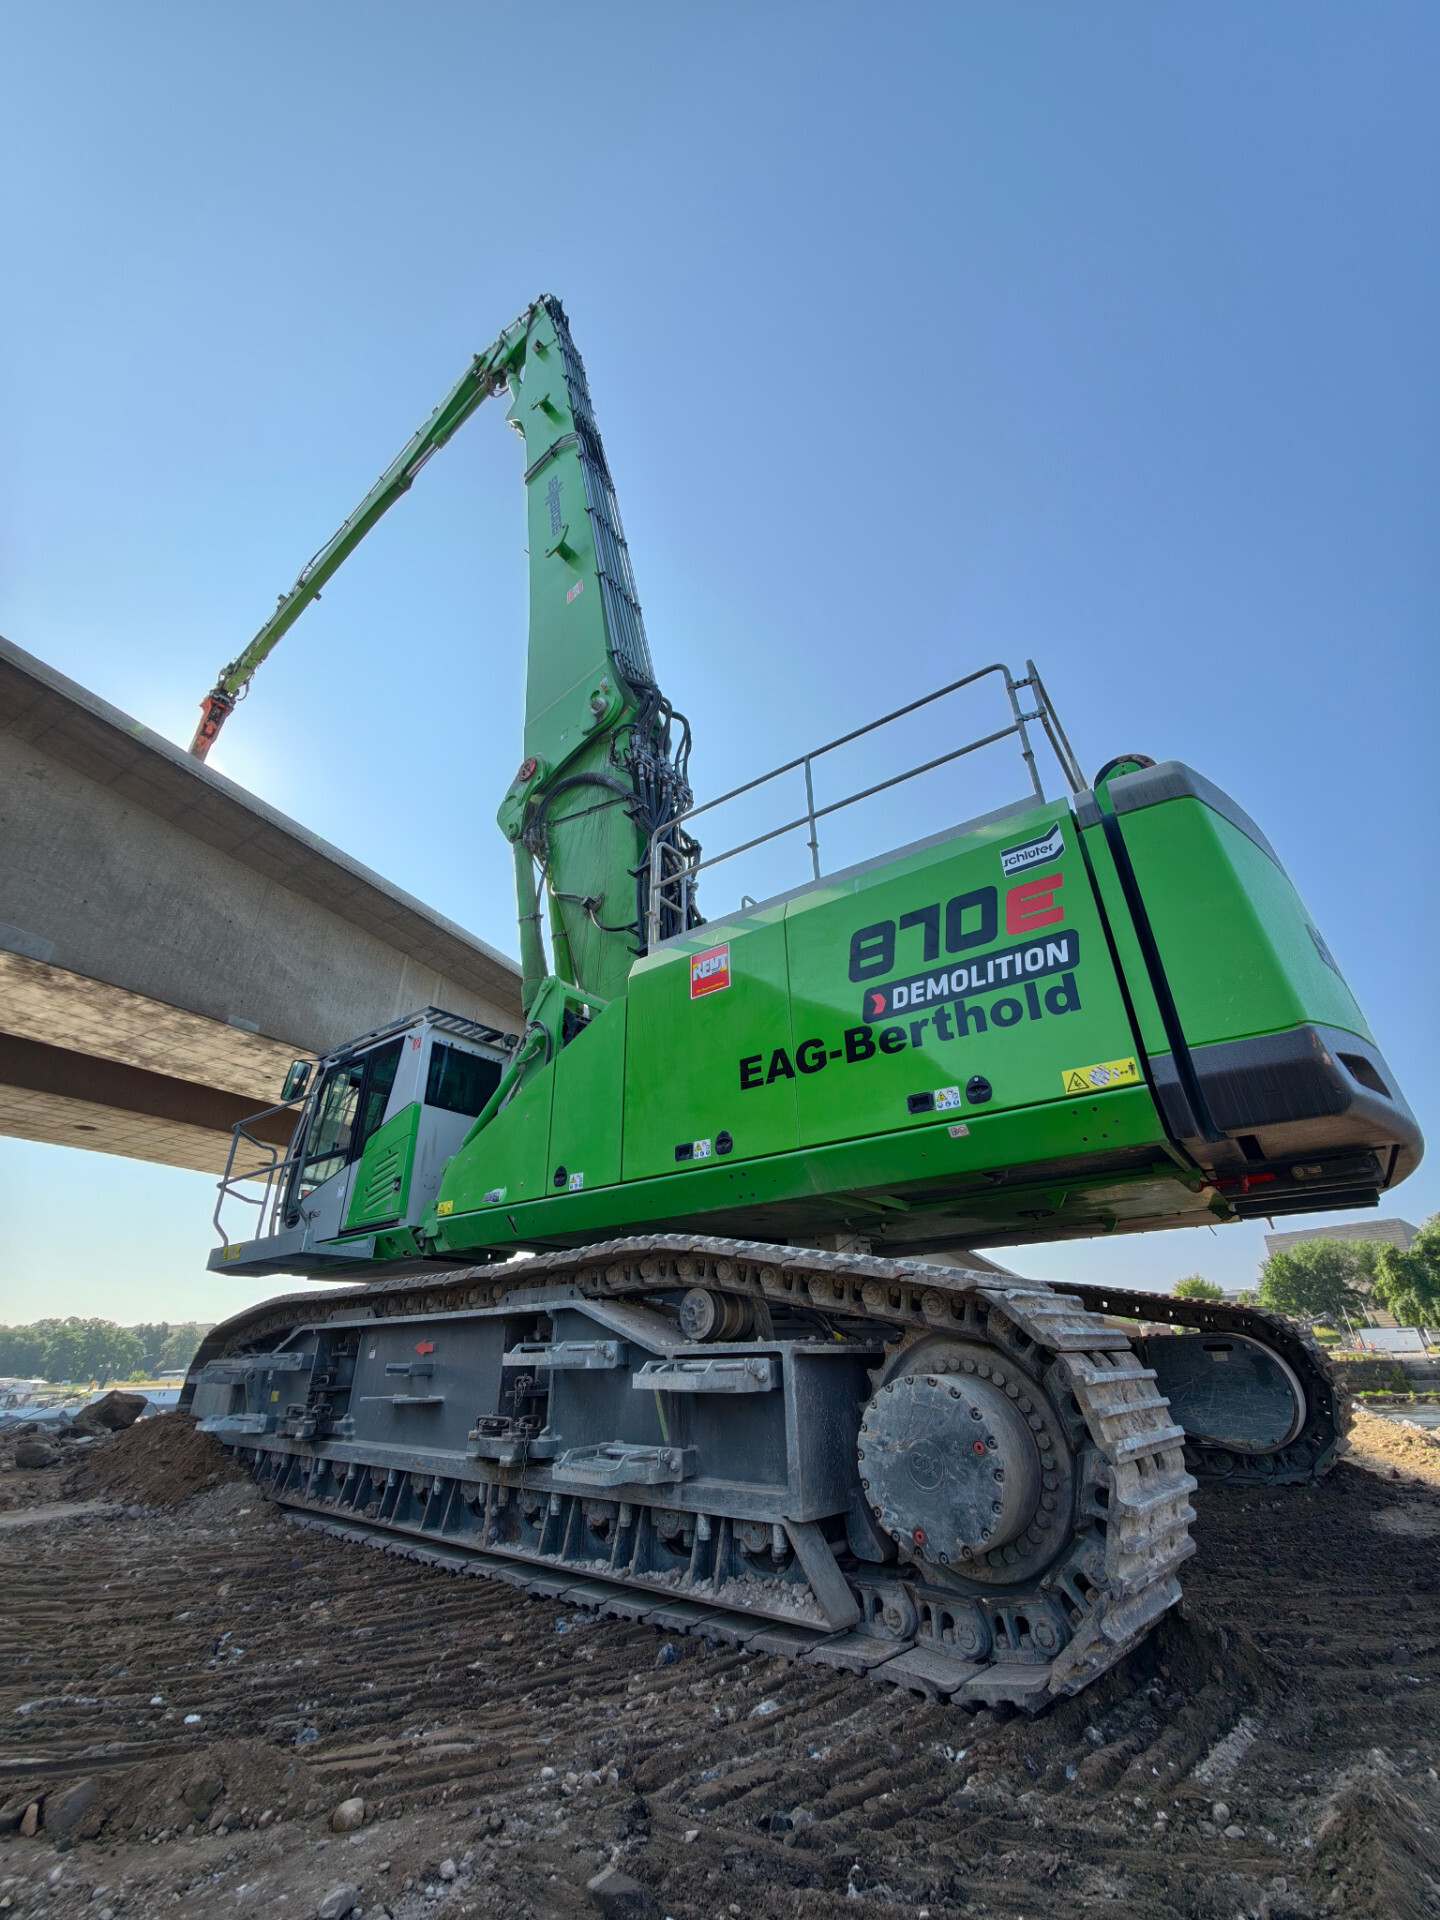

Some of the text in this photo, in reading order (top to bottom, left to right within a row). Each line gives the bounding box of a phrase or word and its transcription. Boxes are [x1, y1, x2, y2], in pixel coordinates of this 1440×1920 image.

[848, 872, 1064, 983] 870E
[892, 938, 1069, 1010] DEMOLITION
[739, 972, 1082, 1090] EAG-Berthold
